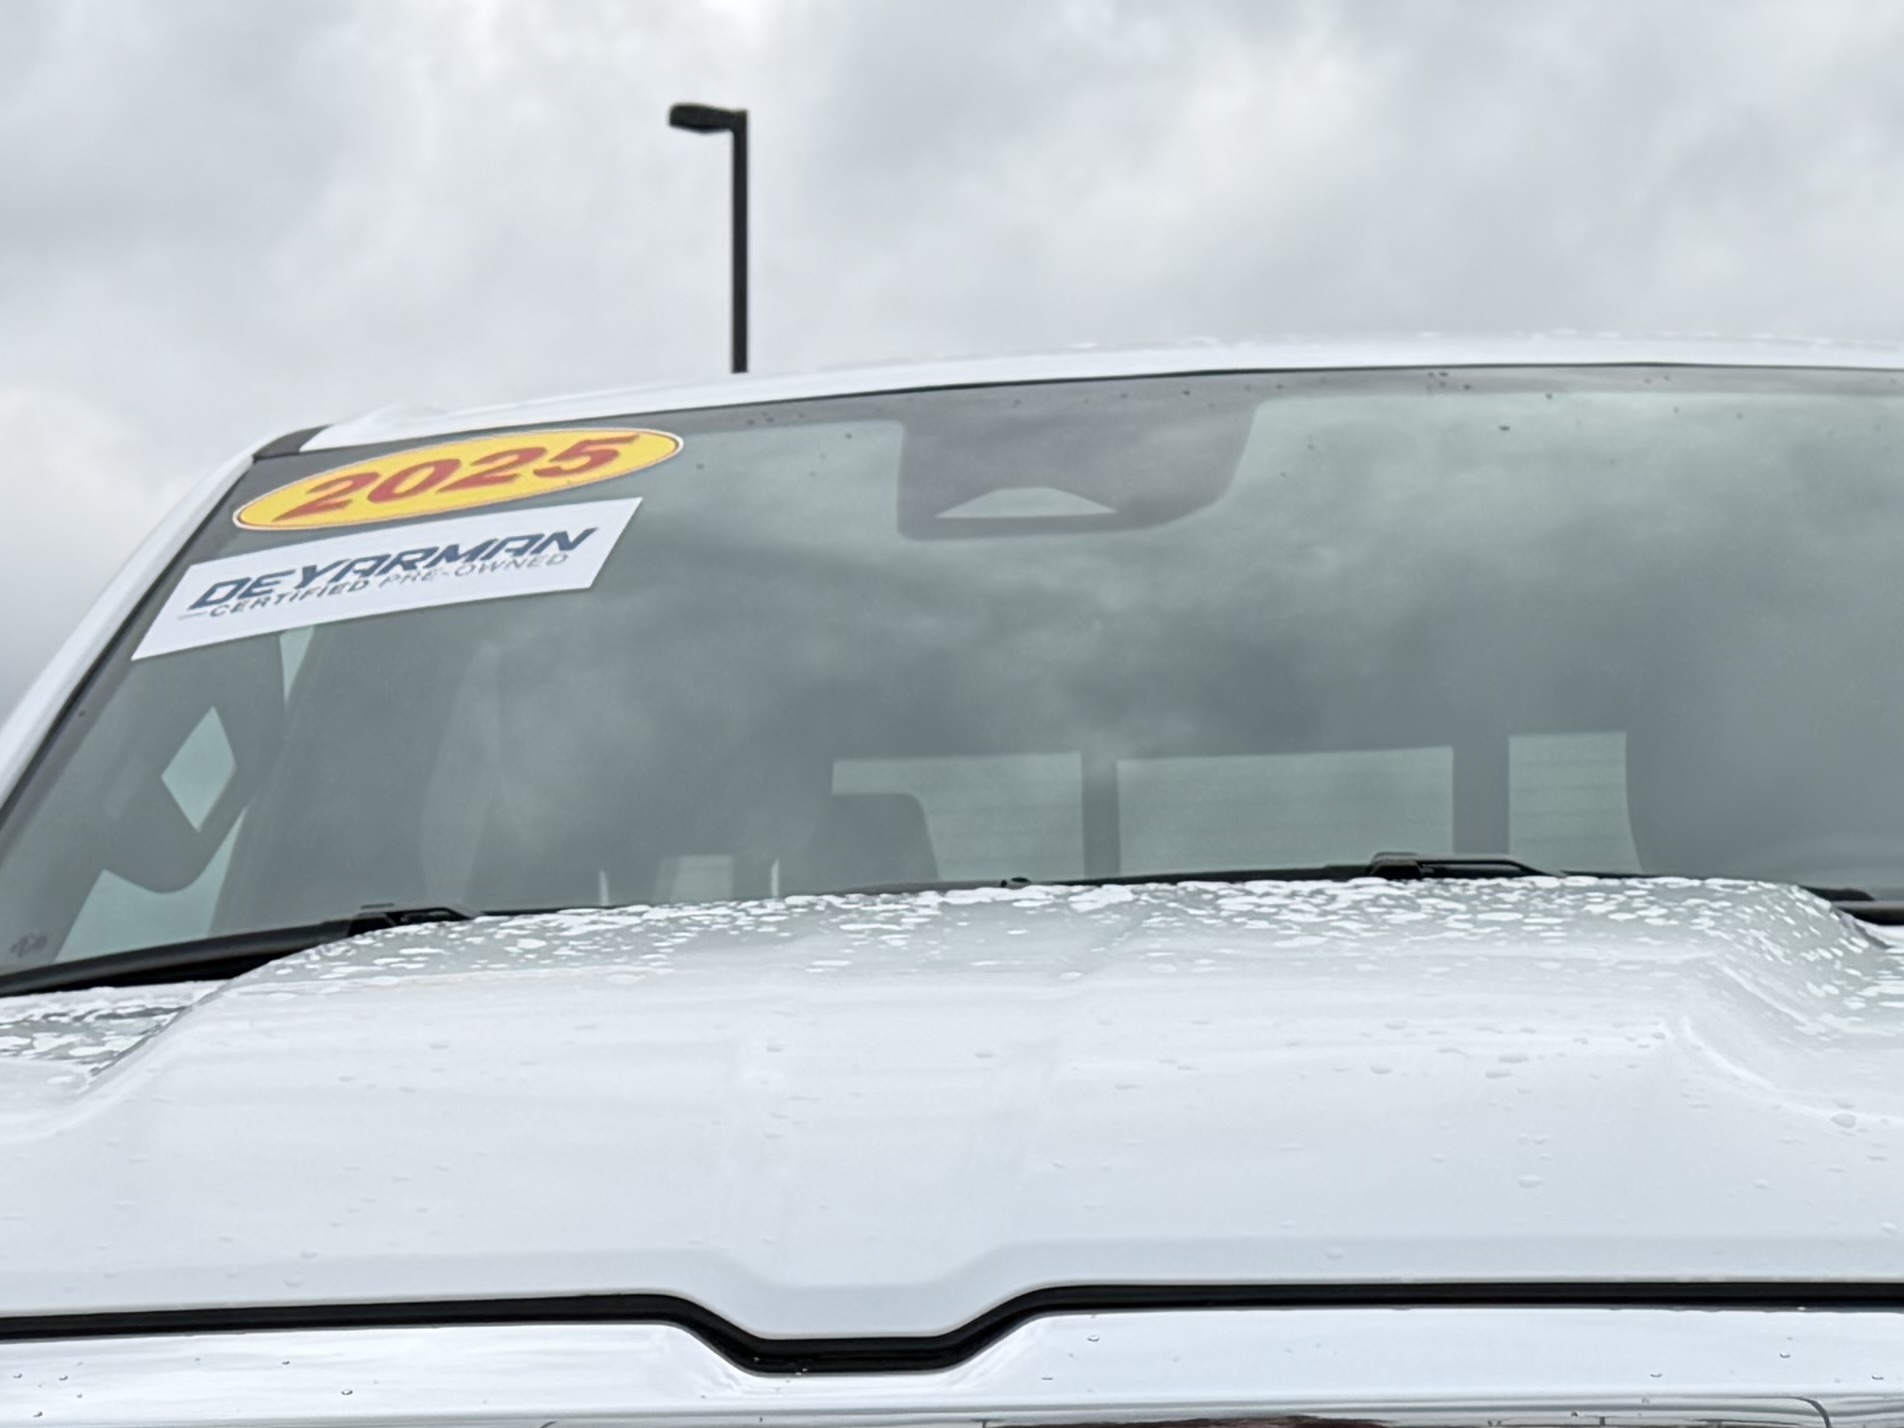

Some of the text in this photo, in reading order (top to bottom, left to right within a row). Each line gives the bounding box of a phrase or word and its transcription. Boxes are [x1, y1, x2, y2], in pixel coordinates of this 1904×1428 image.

[272, 434, 641, 522] 2025
[188, 526, 599, 611] DEYARMAN
[209, 552, 569, 618] CERTIFIED PRE-OWNED
